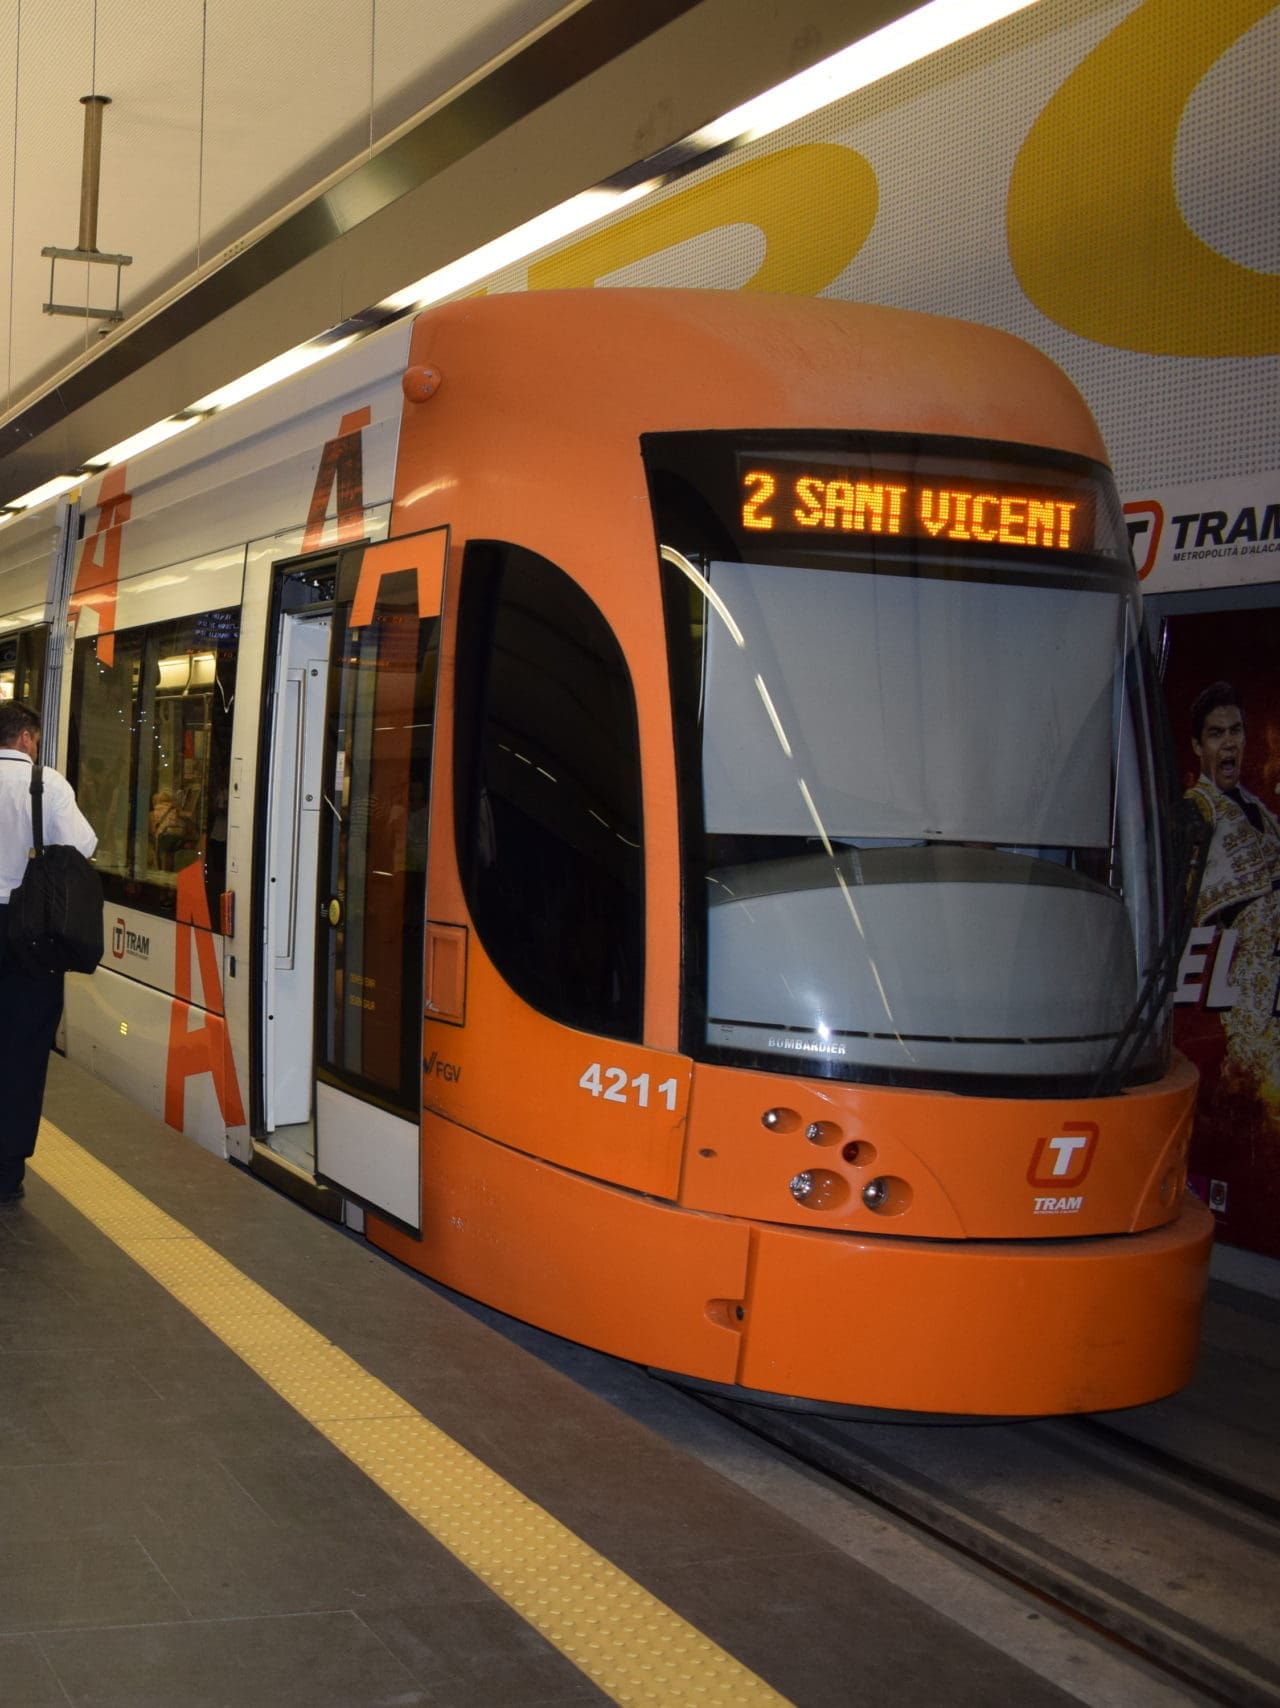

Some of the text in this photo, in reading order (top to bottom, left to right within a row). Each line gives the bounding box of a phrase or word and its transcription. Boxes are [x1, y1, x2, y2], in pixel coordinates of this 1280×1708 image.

[743, 473, 1077, 549] 2 SANT VICENT
[126, 930, 150, 956] TRAM
[767, 1036, 847, 1056] BOMBARDIER
[436, 1061, 462, 1084] FGV
[579, 1063, 677, 1111] 4211
[1033, 1195, 1085, 1210] TRAM
